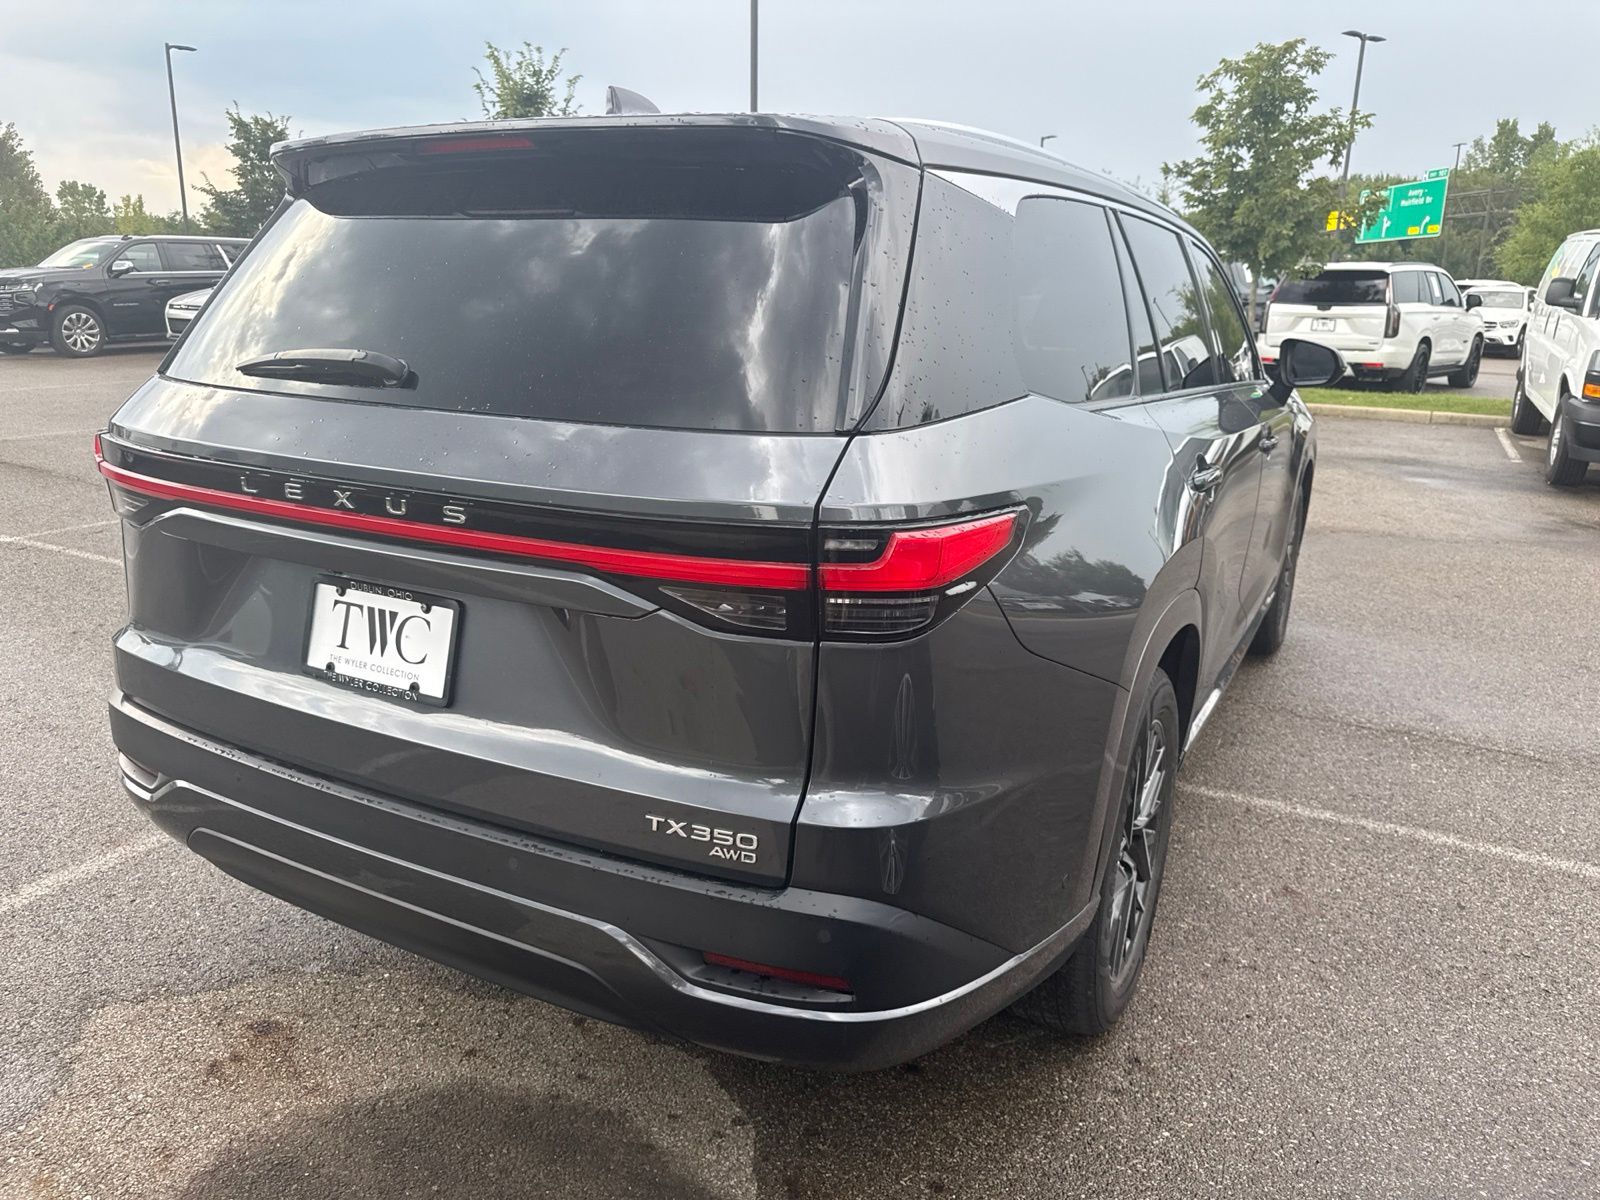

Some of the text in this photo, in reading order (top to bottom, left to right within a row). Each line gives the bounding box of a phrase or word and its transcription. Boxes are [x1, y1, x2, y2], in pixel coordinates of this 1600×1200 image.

[240, 476, 466, 524] LEXUS
[350, 581, 413, 601] DUBLIN, OHIO
[332, 599, 431, 665] TWC
[330, 654, 420, 680] THE WYLER COLLECTION
[324, 670, 418, 701] THE WYLER COLLECTION
[645, 815, 758, 850] TX350
[709, 846, 757, 864] AWD
